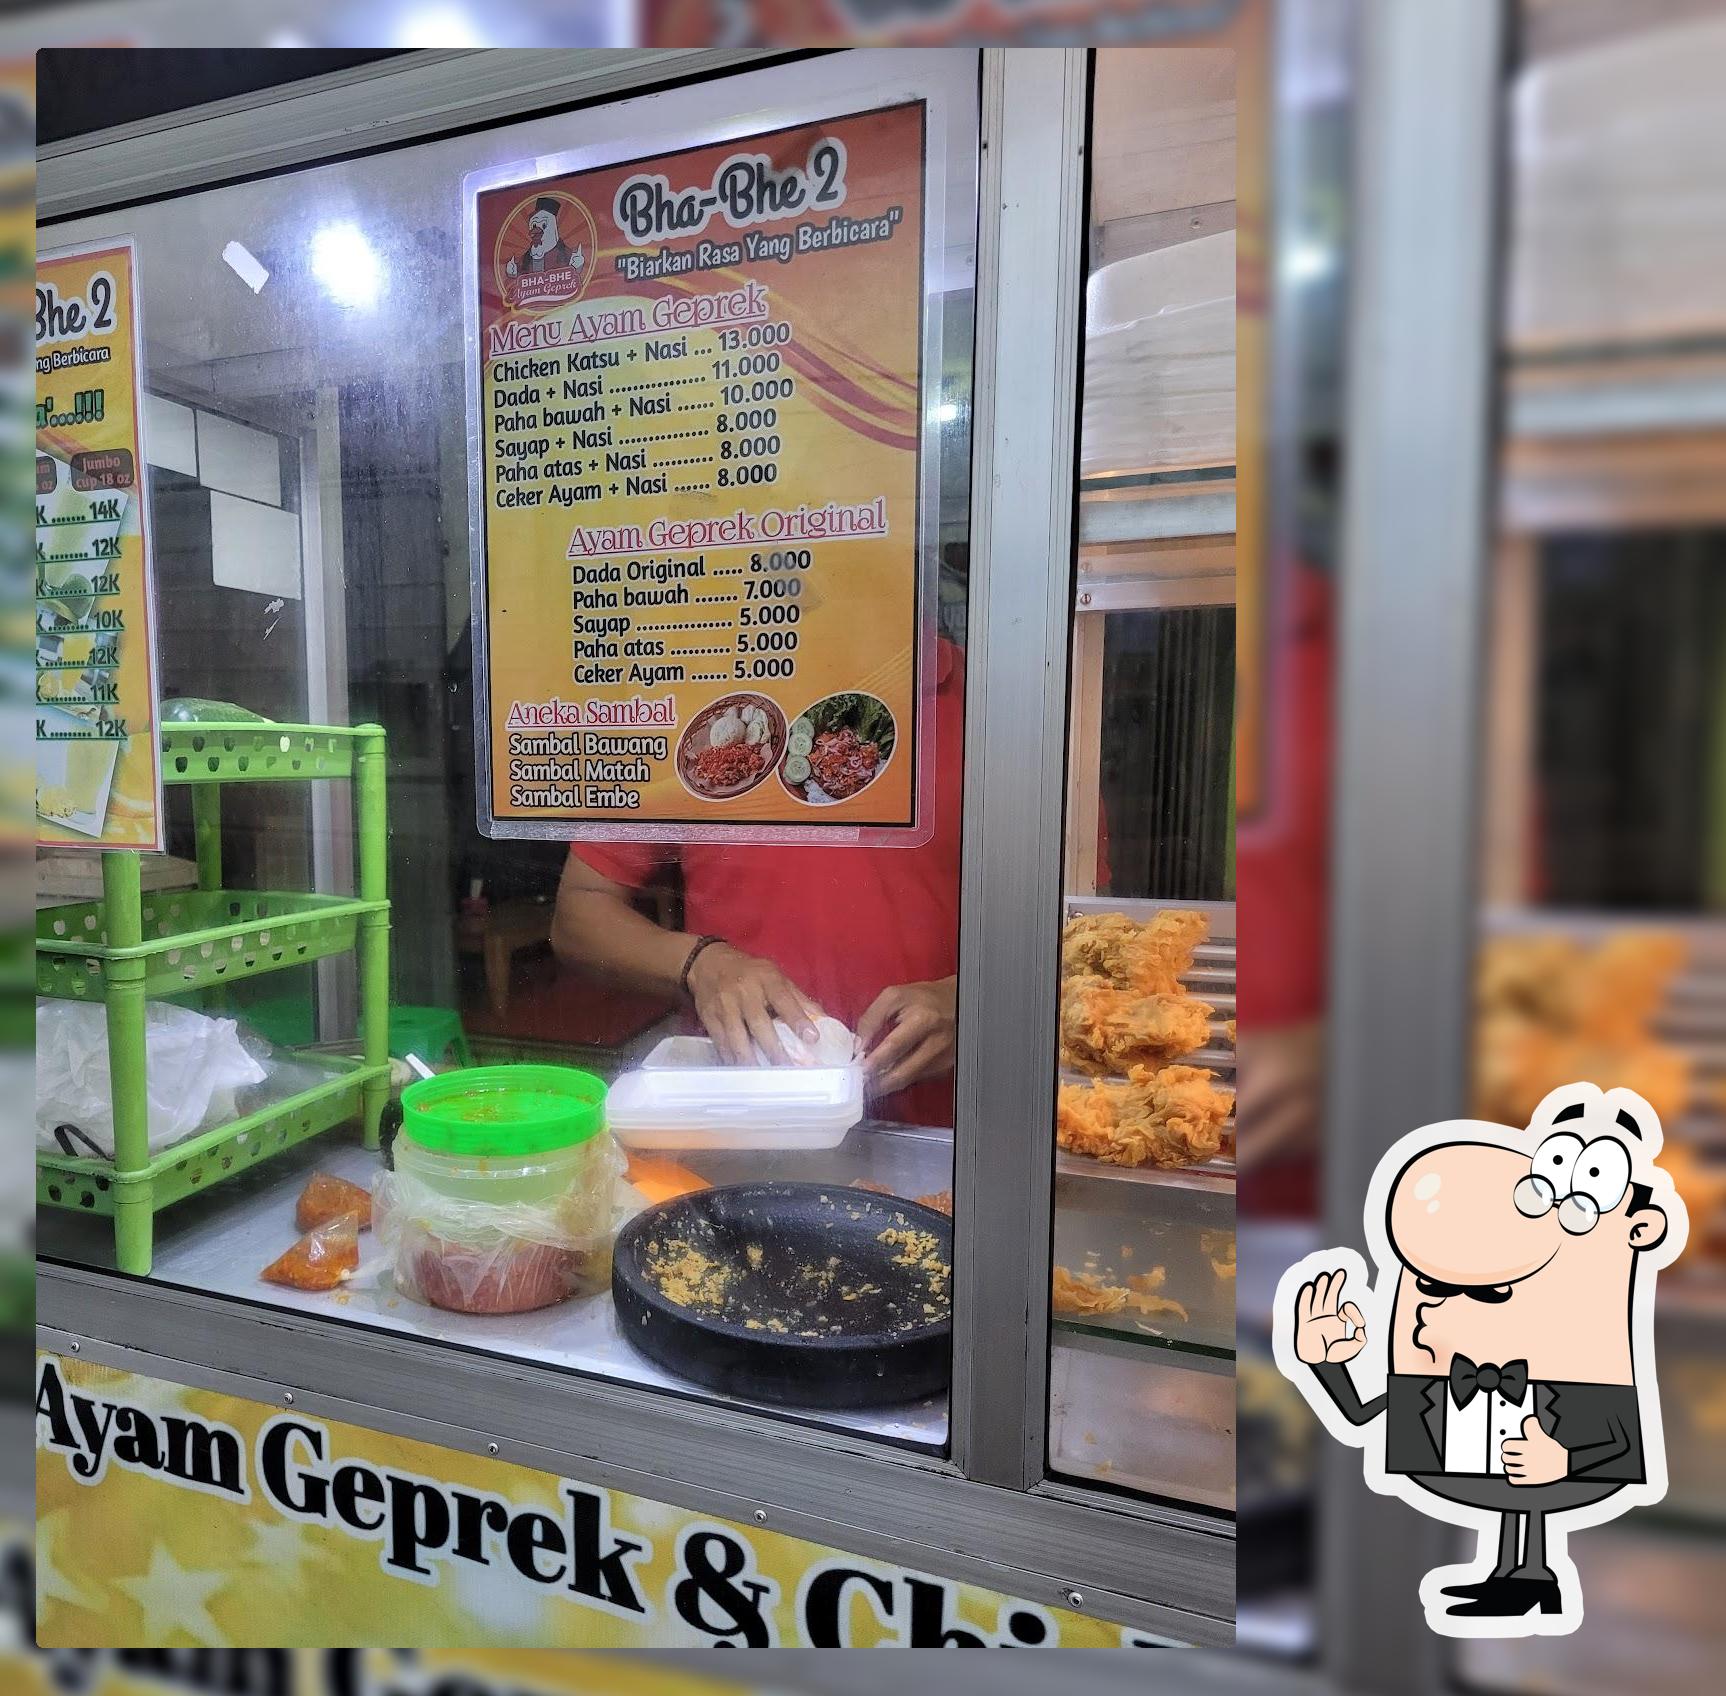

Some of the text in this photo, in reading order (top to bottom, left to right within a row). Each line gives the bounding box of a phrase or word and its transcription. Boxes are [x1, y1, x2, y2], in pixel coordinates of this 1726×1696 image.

[618, 145, 840, 238] Bha-Bhe 2
[616, 208, 902, 280] "Biarkan Rasa Yang Berbicara"
[509, 279, 578, 300] Ayam Geprek
[521, 270, 573, 288] BHA-BHE
[90, 276, 113, 329] 2
[488, 282, 766, 353] Menu Ayam Geprek
[52, 345, 110, 369] Berbicara
[493, 322, 790, 383] Chicken Katsu + Nasi 13.000
[494, 352, 780, 409] Dada + Nasi 11.000
[494, 378, 794, 434] Paha bawah + Nasi 10.000
[495, 408, 777, 461] Sayap + Nasi 8.000
[495, 435, 781, 484] Paha atas + Nasi 8.000
[75, 472, 132, 491] cup 18 oz
[496, 462, 778, 508] Ceker Ayam + Nasi 8.000
[89, 498, 121, 521] 14K
[568, 499, 886, 556] Ayam Geprek Original
[91, 536, 122, 558] 12K
[573, 550, 812, 585] Dada Original 8.000
[90, 572, 120, 594] 12K
[573, 577, 802, 610] Paha bawah 7.000
[93, 609, 124, 630] 10K
[573, 604, 801, 638] Sayap 5.000
[88, 646, 120, 666] 12K
[574, 631, 798, 660] Paha atas 5.000
[574, 658, 794, 687] Ceker Ayam 5.000
[90, 682, 120, 702] 11K
[507, 696, 676, 726] Aneka Sambal
[96, 718, 127, 738] 12K
[509, 731, 668, 761] Sambal Bawang
[509, 757, 651, 783] Sambal Matah
[510, 784, 641, 809] Sambal Embe
[36, 1361, 245, 1496] Ayam
[261, 1420, 646, 1614] Geprek
[673, 1530, 770, 1648] &
